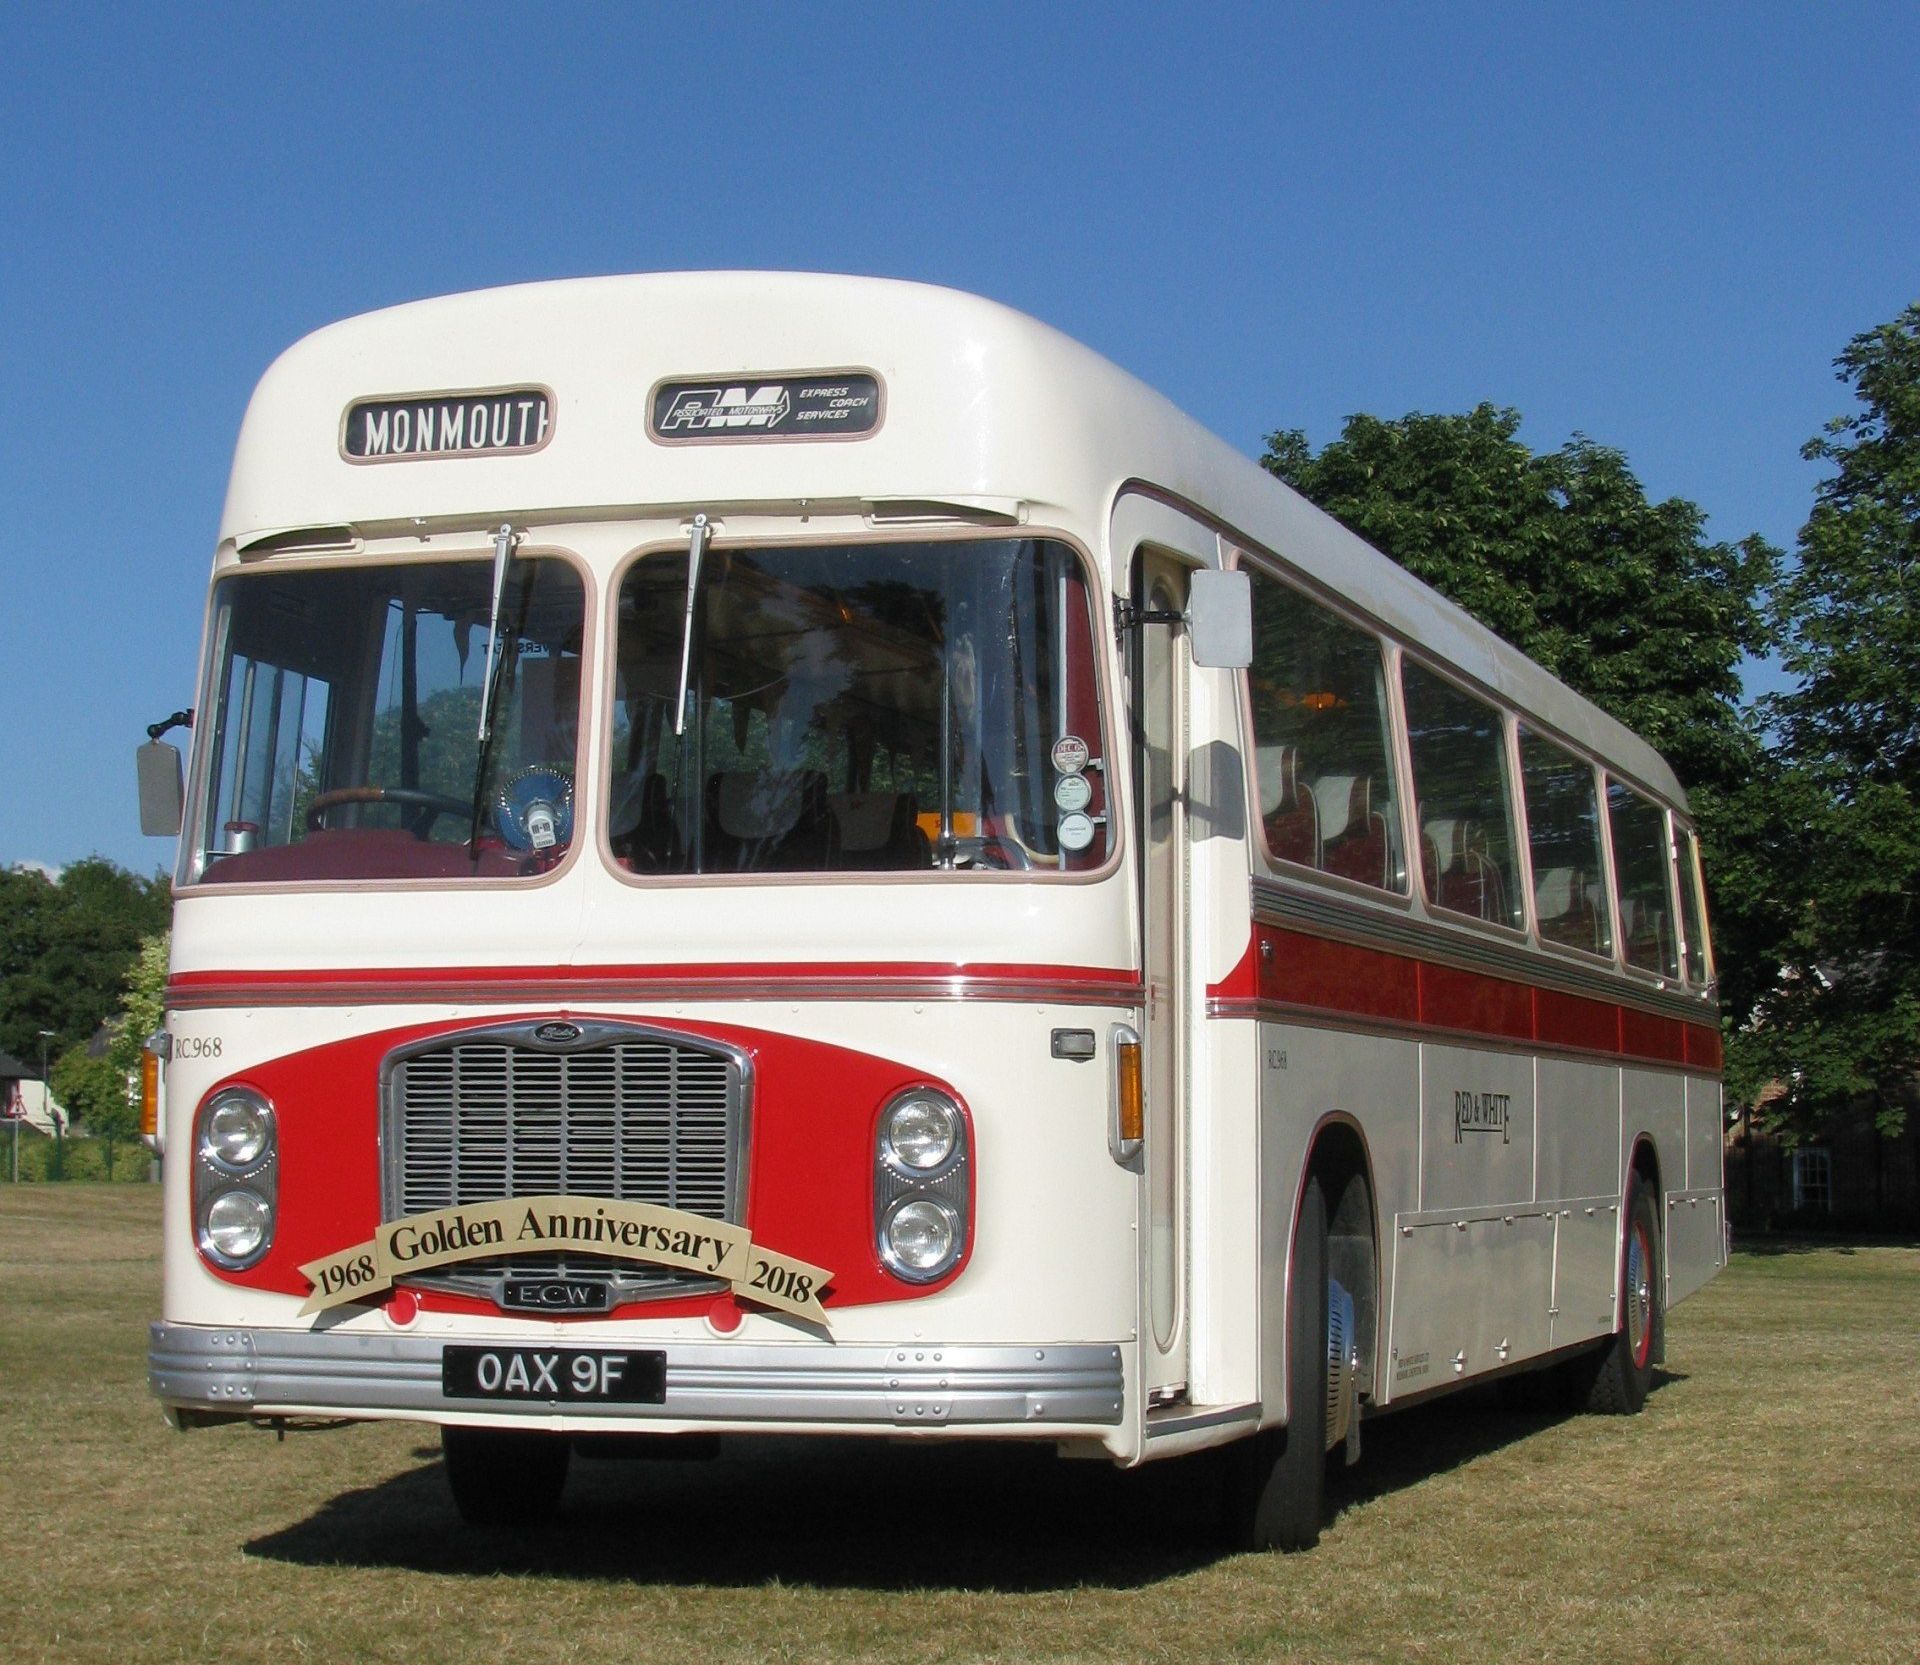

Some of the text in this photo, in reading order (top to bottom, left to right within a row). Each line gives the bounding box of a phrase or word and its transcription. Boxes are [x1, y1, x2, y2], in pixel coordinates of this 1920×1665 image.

[800, 387, 849, 398] EXPRESS
[672, 404, 785, 418] ASSOCIATED MOTORWAYS
[829, 397, 870, 408] COACH
[796, 409, 849, 420] SERVICES
[1454, 1090, 1511, 1144] RED & WHITE
[318, 1207, 813, 1303] 1968 Golden Anniversary 2018
[519, 1285, 590, 1305] ECW
[477, 1352, 628, 1395] OAX 9F
